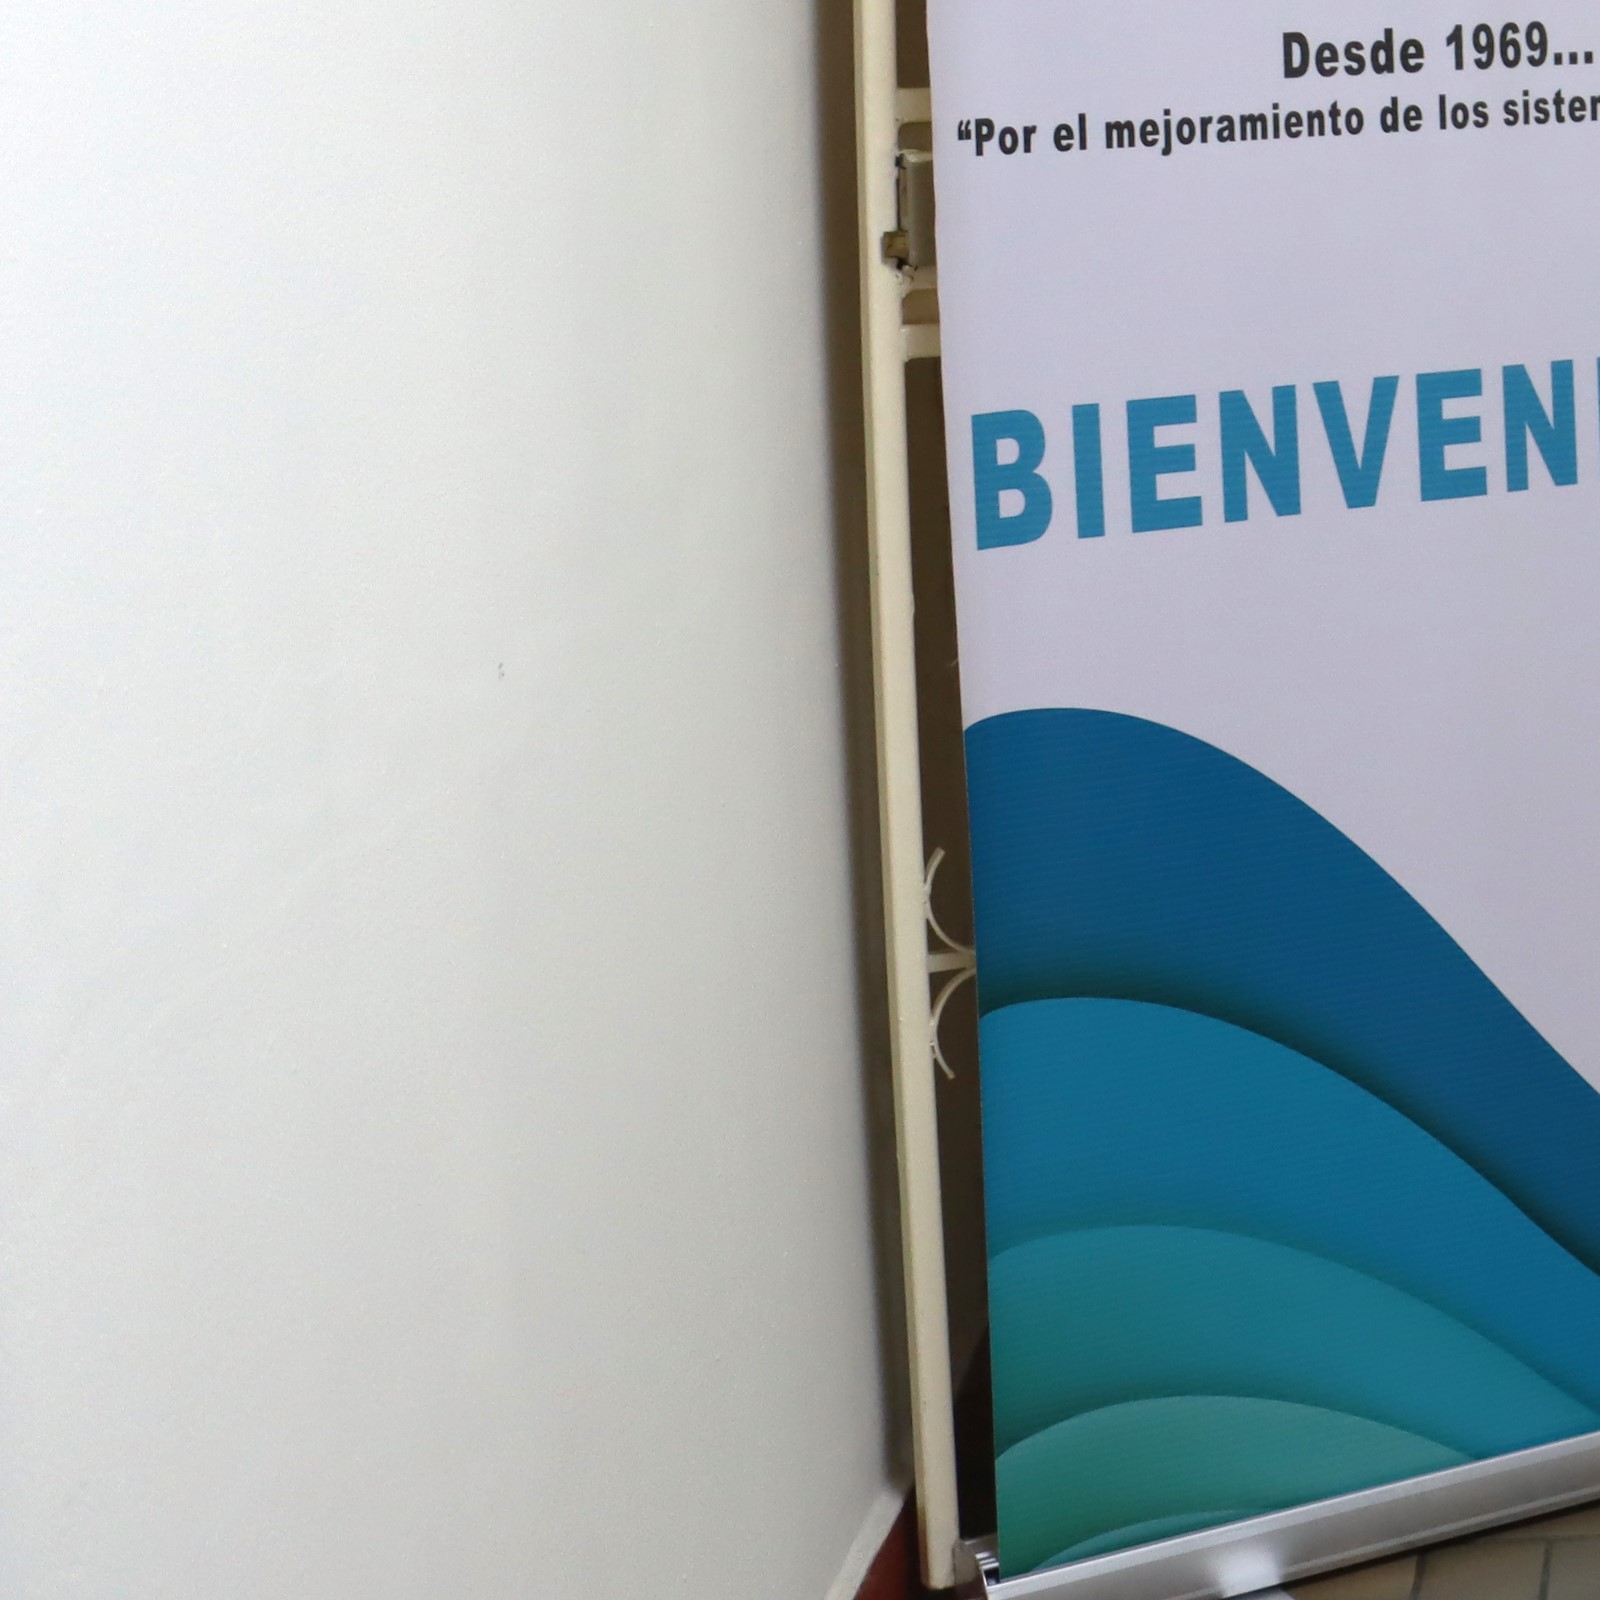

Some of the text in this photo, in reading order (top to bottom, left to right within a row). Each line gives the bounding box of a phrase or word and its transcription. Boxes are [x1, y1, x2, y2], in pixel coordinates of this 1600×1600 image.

[1282, 21, 1595, 80] Desde 1969...
[1053, 112, 1088, 152] el
[1105, 99, 1365, 157] mejoramiento
[1380, 96, 1422, 135] de
[1437, 91, 1489, 131] los
